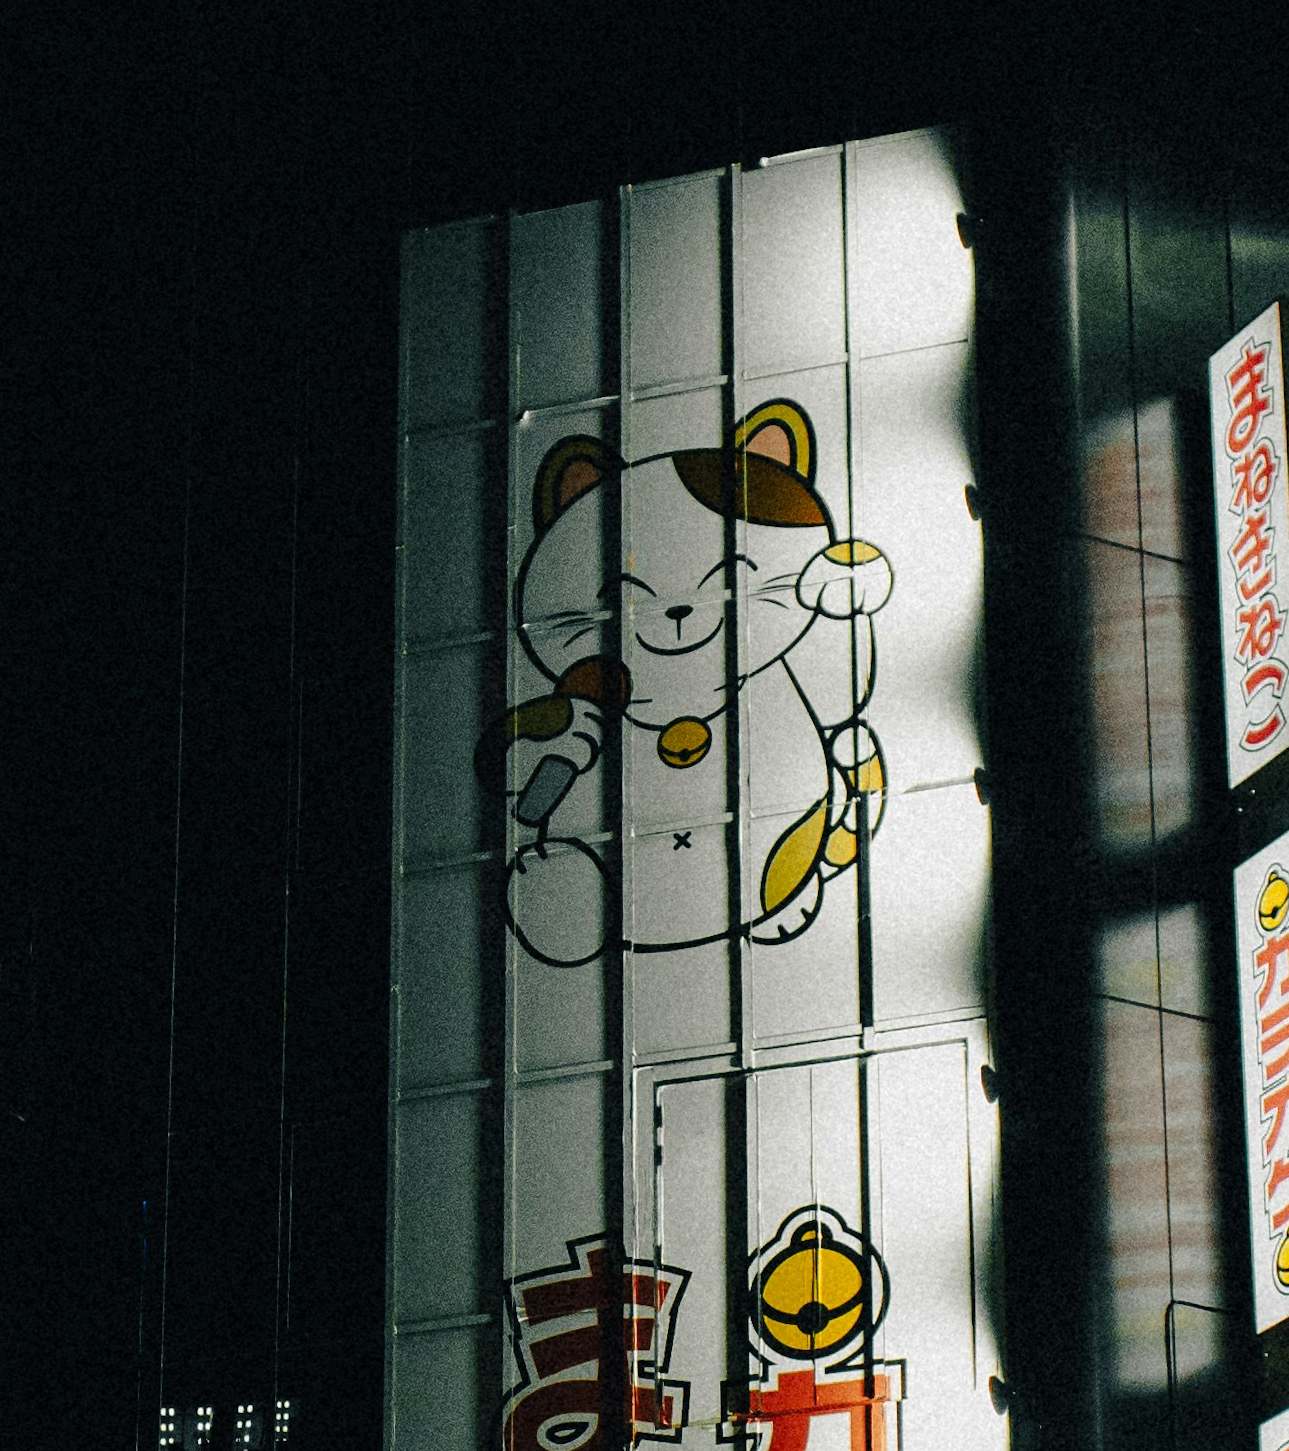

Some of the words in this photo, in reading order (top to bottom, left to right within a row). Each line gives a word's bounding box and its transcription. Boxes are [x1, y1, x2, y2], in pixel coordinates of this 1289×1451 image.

[1227, 344, 1285, 748] まねきねこ
